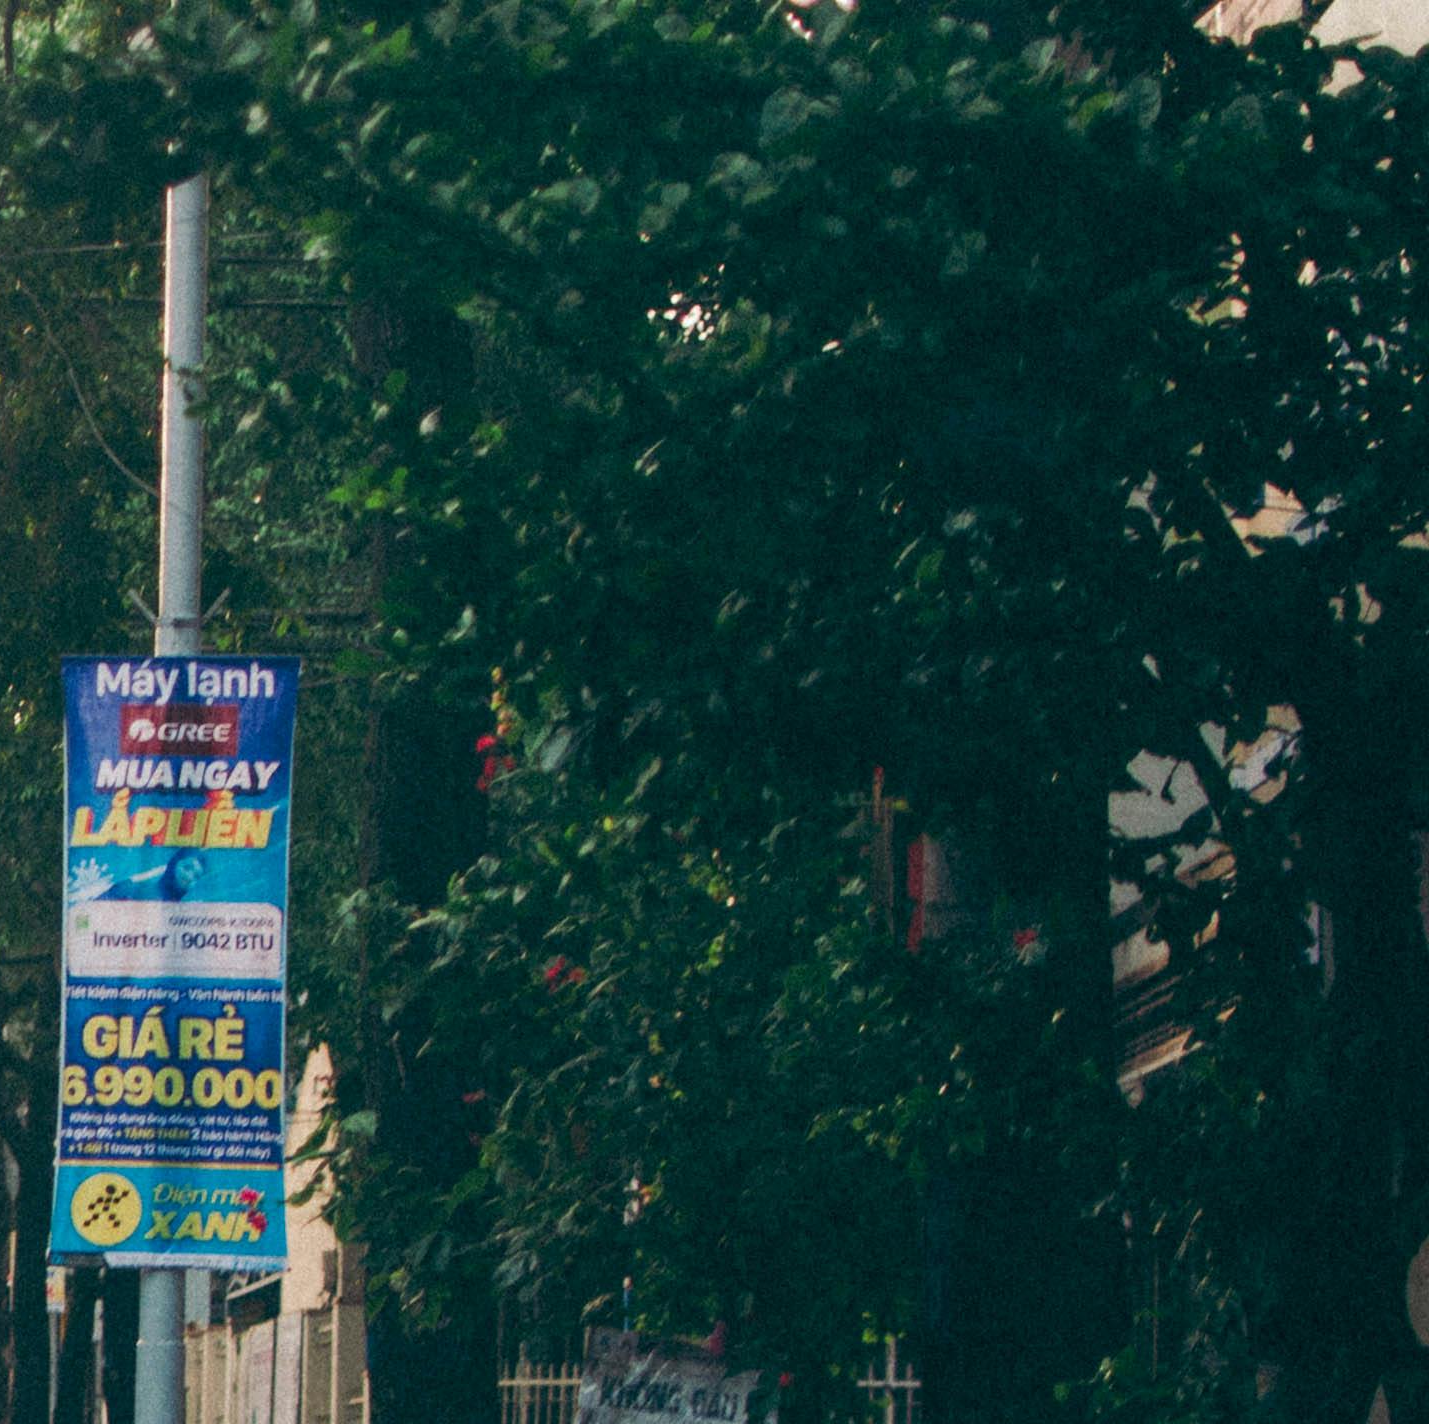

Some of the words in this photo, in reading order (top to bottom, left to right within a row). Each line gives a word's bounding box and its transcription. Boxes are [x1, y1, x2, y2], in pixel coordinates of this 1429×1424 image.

[96, 659, 179, 706] Máy
[188, 661, 275, 706] lạnh
[157, 722, 231, 743] GREE
[96, 759, 174, 789] MUA
[178, 760, 280, 790] NGAY
[93, 931, 169, 949] Inverter
[181, 932, 230, 950] 9042
[235, 934, 274, 950] BTU
[82, 1005, 169, 1059] GIÁ
[178, 1004, 244, 1060] RẺ
[63, 1065, 282, 1109] 6.990.000
[191, 1127, 201, 1140] 2
[110, 1144, 142, 1157] trong
[153, 1183, 208, 1207] Điện
[144, 1210, 264, 1242] XANH
